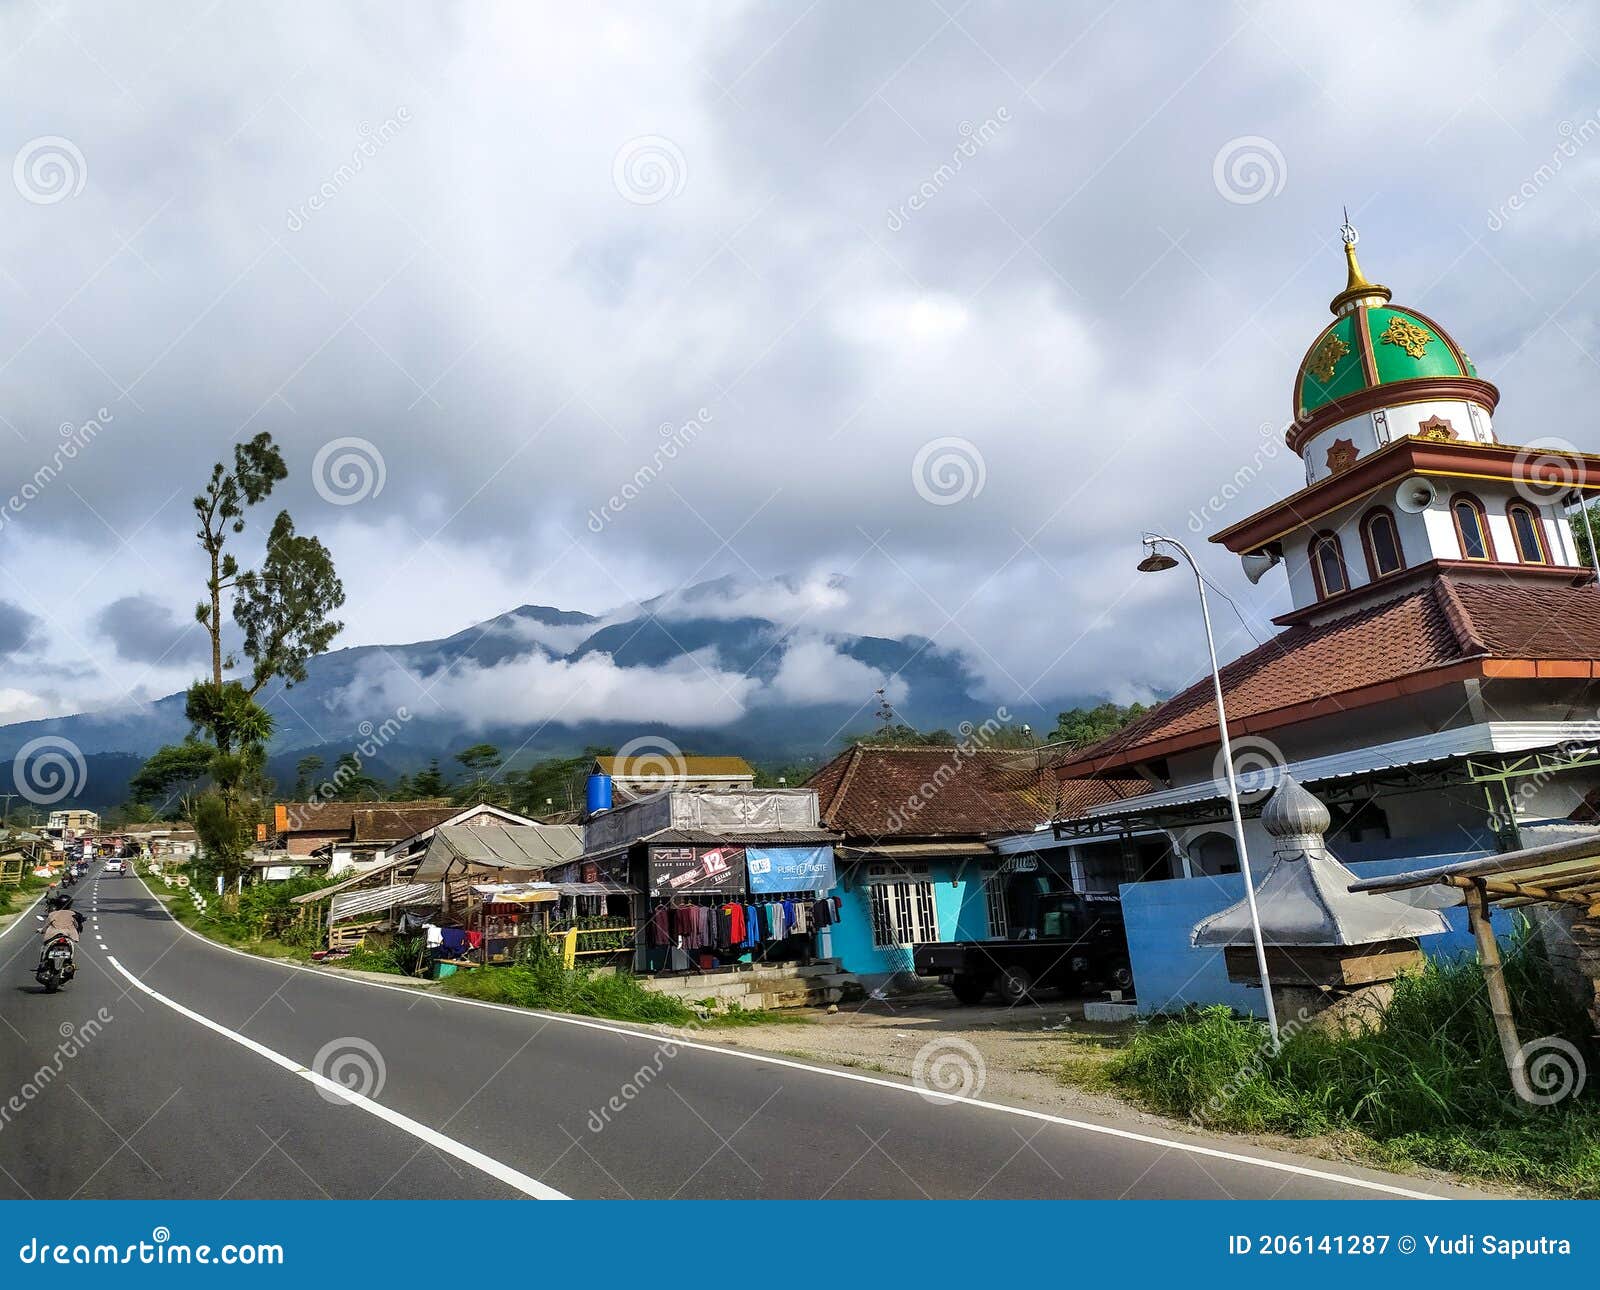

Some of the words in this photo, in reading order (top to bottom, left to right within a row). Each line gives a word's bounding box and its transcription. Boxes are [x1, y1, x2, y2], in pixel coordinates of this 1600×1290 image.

[703, 852, 727, 873] 12
[777, 864, 796, 874] PURE
[807, 863, 828, 872] TASTE
